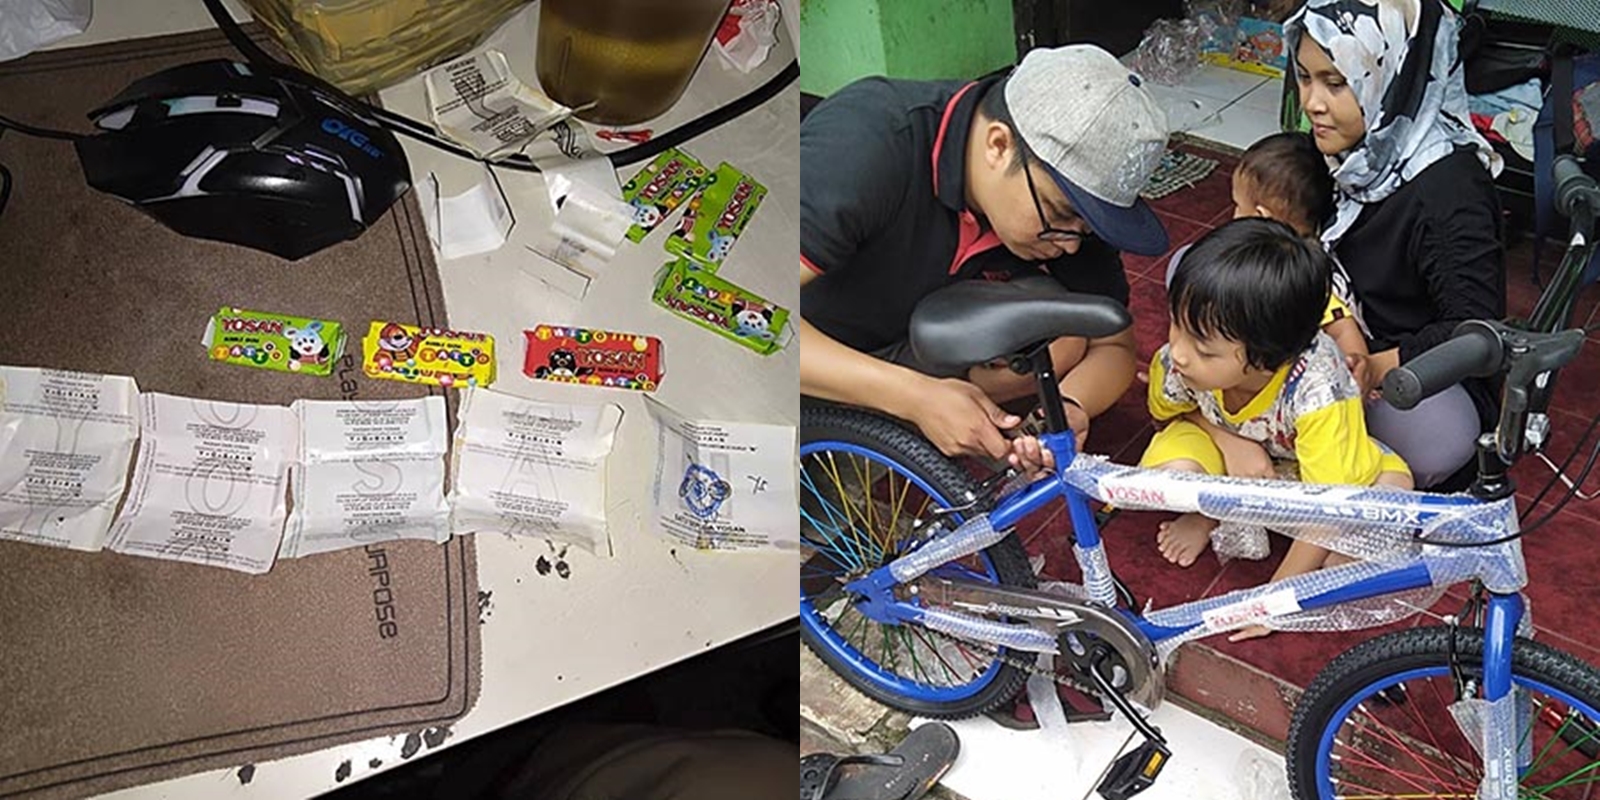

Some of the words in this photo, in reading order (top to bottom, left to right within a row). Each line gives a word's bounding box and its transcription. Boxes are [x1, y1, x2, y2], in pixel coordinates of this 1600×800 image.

[640, 159, 683, 200] YOSAN
[716, 181, 753, 229] YOSAN
[665, 294, 730, 328] YOSAN
[222, 317, 284, 334] YOSAN
[577, 347, 646, 369] YOSAN
[1104, 485, 1165, 505] YOSAN
[1363, 507, 1420, 526] BMX
